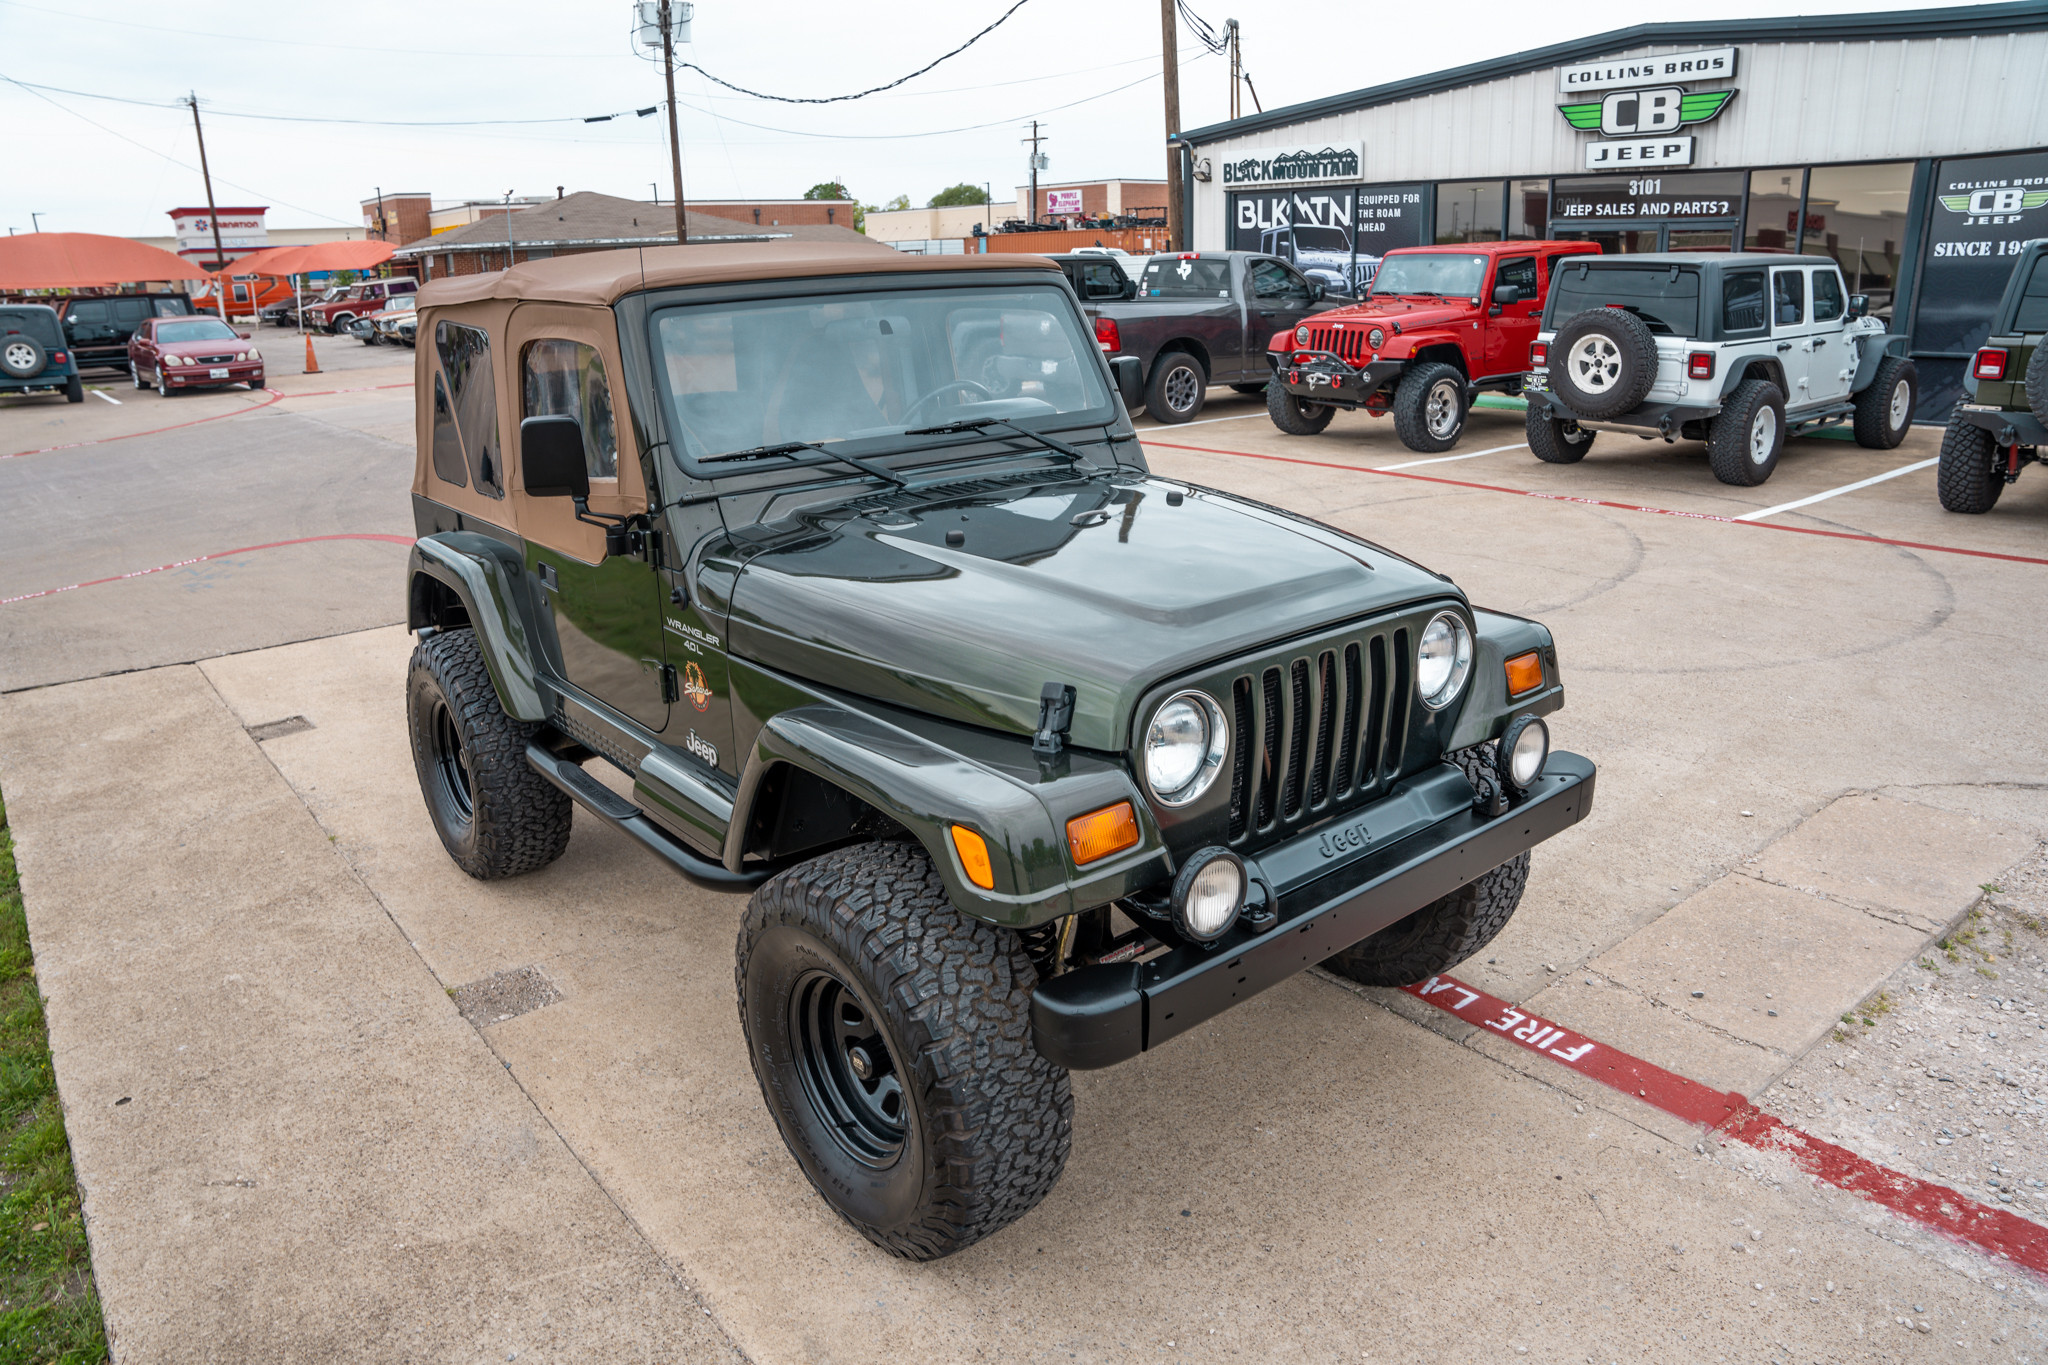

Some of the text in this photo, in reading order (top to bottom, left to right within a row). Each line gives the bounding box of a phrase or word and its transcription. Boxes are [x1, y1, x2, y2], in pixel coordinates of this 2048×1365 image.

[1567, 57, 1724, 84] COLLINS BROS
[1601, 87, 1683, 135] CB
[1594, 144, 1682, 162] JEEP
[1628, 178, 1661, 196] 3101
[1949, 180, 2008, 190] COLLINS
[1358, 194, 1420, 205] EQUIPPED FOR
[1968, 189, 2025, 214] CB
[1358, 208, 1401, 218] THE ROAM
[1563, 204, 1593, 217] JEEP
[1595, 203, 1636, 216] SALES
[1639, 202, 1670, 216] AND
[1673, 201, 1718, 214] PARTS
[1357, 222, 1386, 232] AHEAD
[1962, 215, 2022, 226] JEEP
[1933, 241, 1992, 257] SINCE
[666, 616, 720, 647] WRANGLER
[686, 728, 719, 768] Jeep
[1319, 823, 1372, 858] Jeep
[1417, 976, 1595, 1062] FIRE LA
